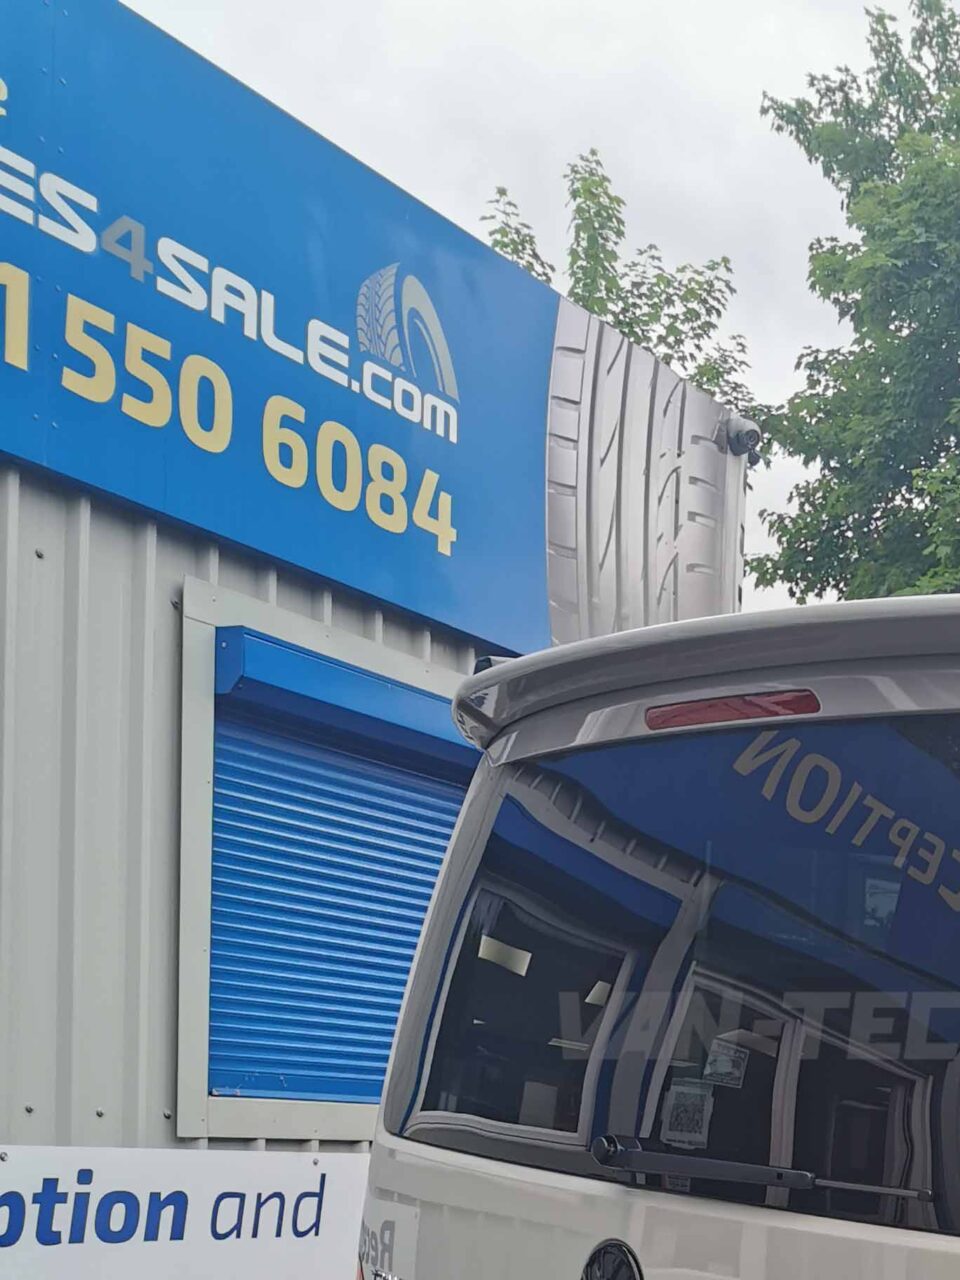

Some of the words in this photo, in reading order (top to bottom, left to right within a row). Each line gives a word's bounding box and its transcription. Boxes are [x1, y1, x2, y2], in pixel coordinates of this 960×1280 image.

[61, 293, 233, 454] 550
[262, 395, 458, 557] 6084
[210, 1172, 327, 1240] and
